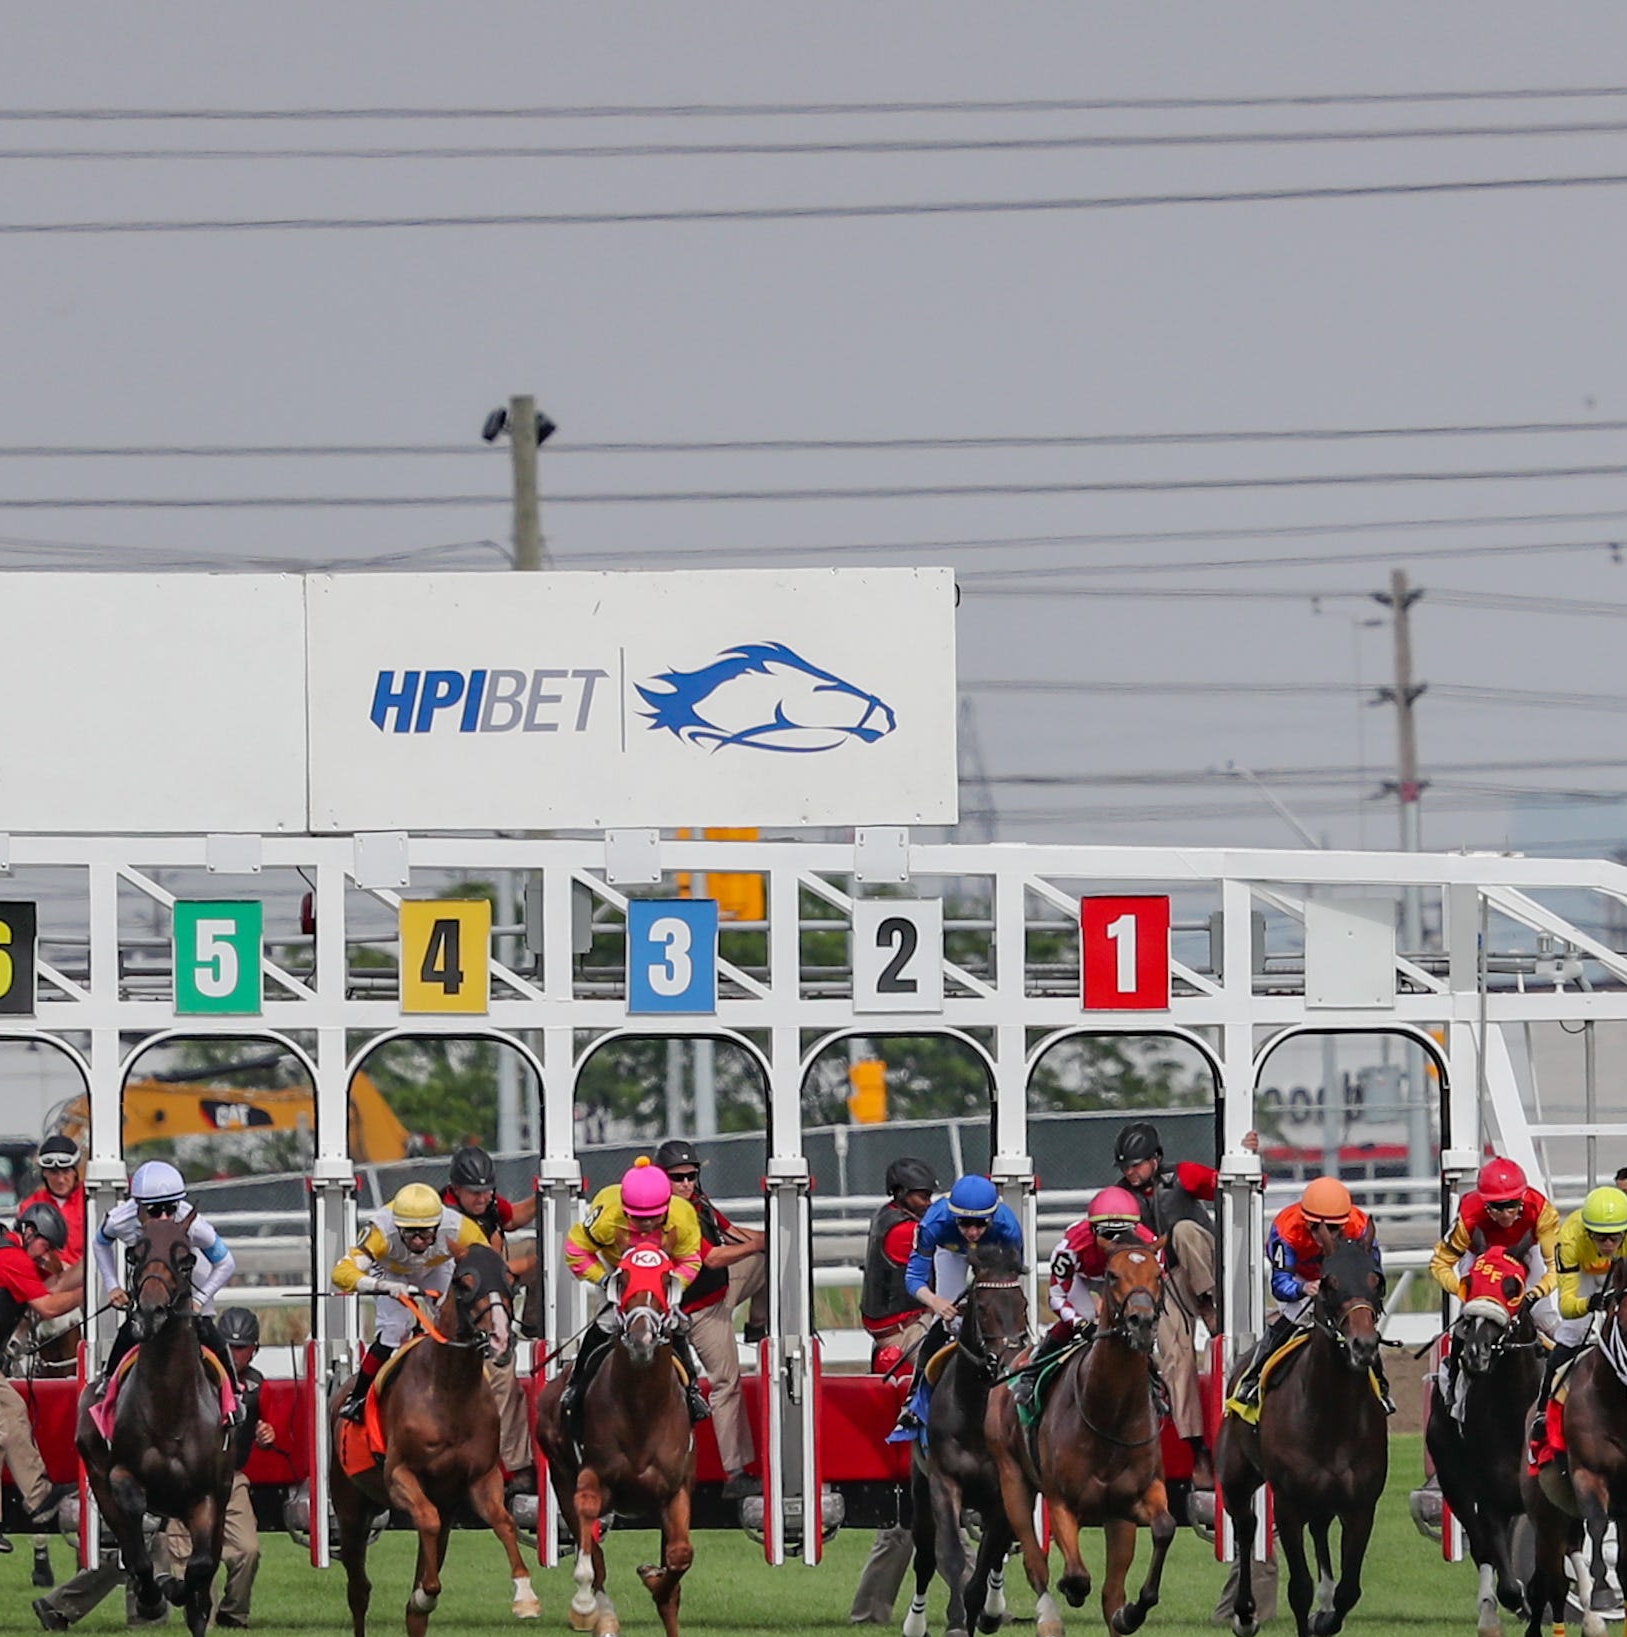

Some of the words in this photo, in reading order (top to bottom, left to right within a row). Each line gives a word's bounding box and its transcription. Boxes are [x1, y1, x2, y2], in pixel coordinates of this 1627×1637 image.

[370, 668, 610, 733] HPIBET
[193, 918, 239, 998] 5
[420, 918, 465, 995] 4
[647, 917, 692, 996] 3
[876, 917, 919, 994] 2
[1106, 914, 1137, 993] 1
[1053, 1255, 1072, 1277] 5
[1274, 1244, 1284, 1269] 4
[1473, 1258, 1504, 1284] SSF
